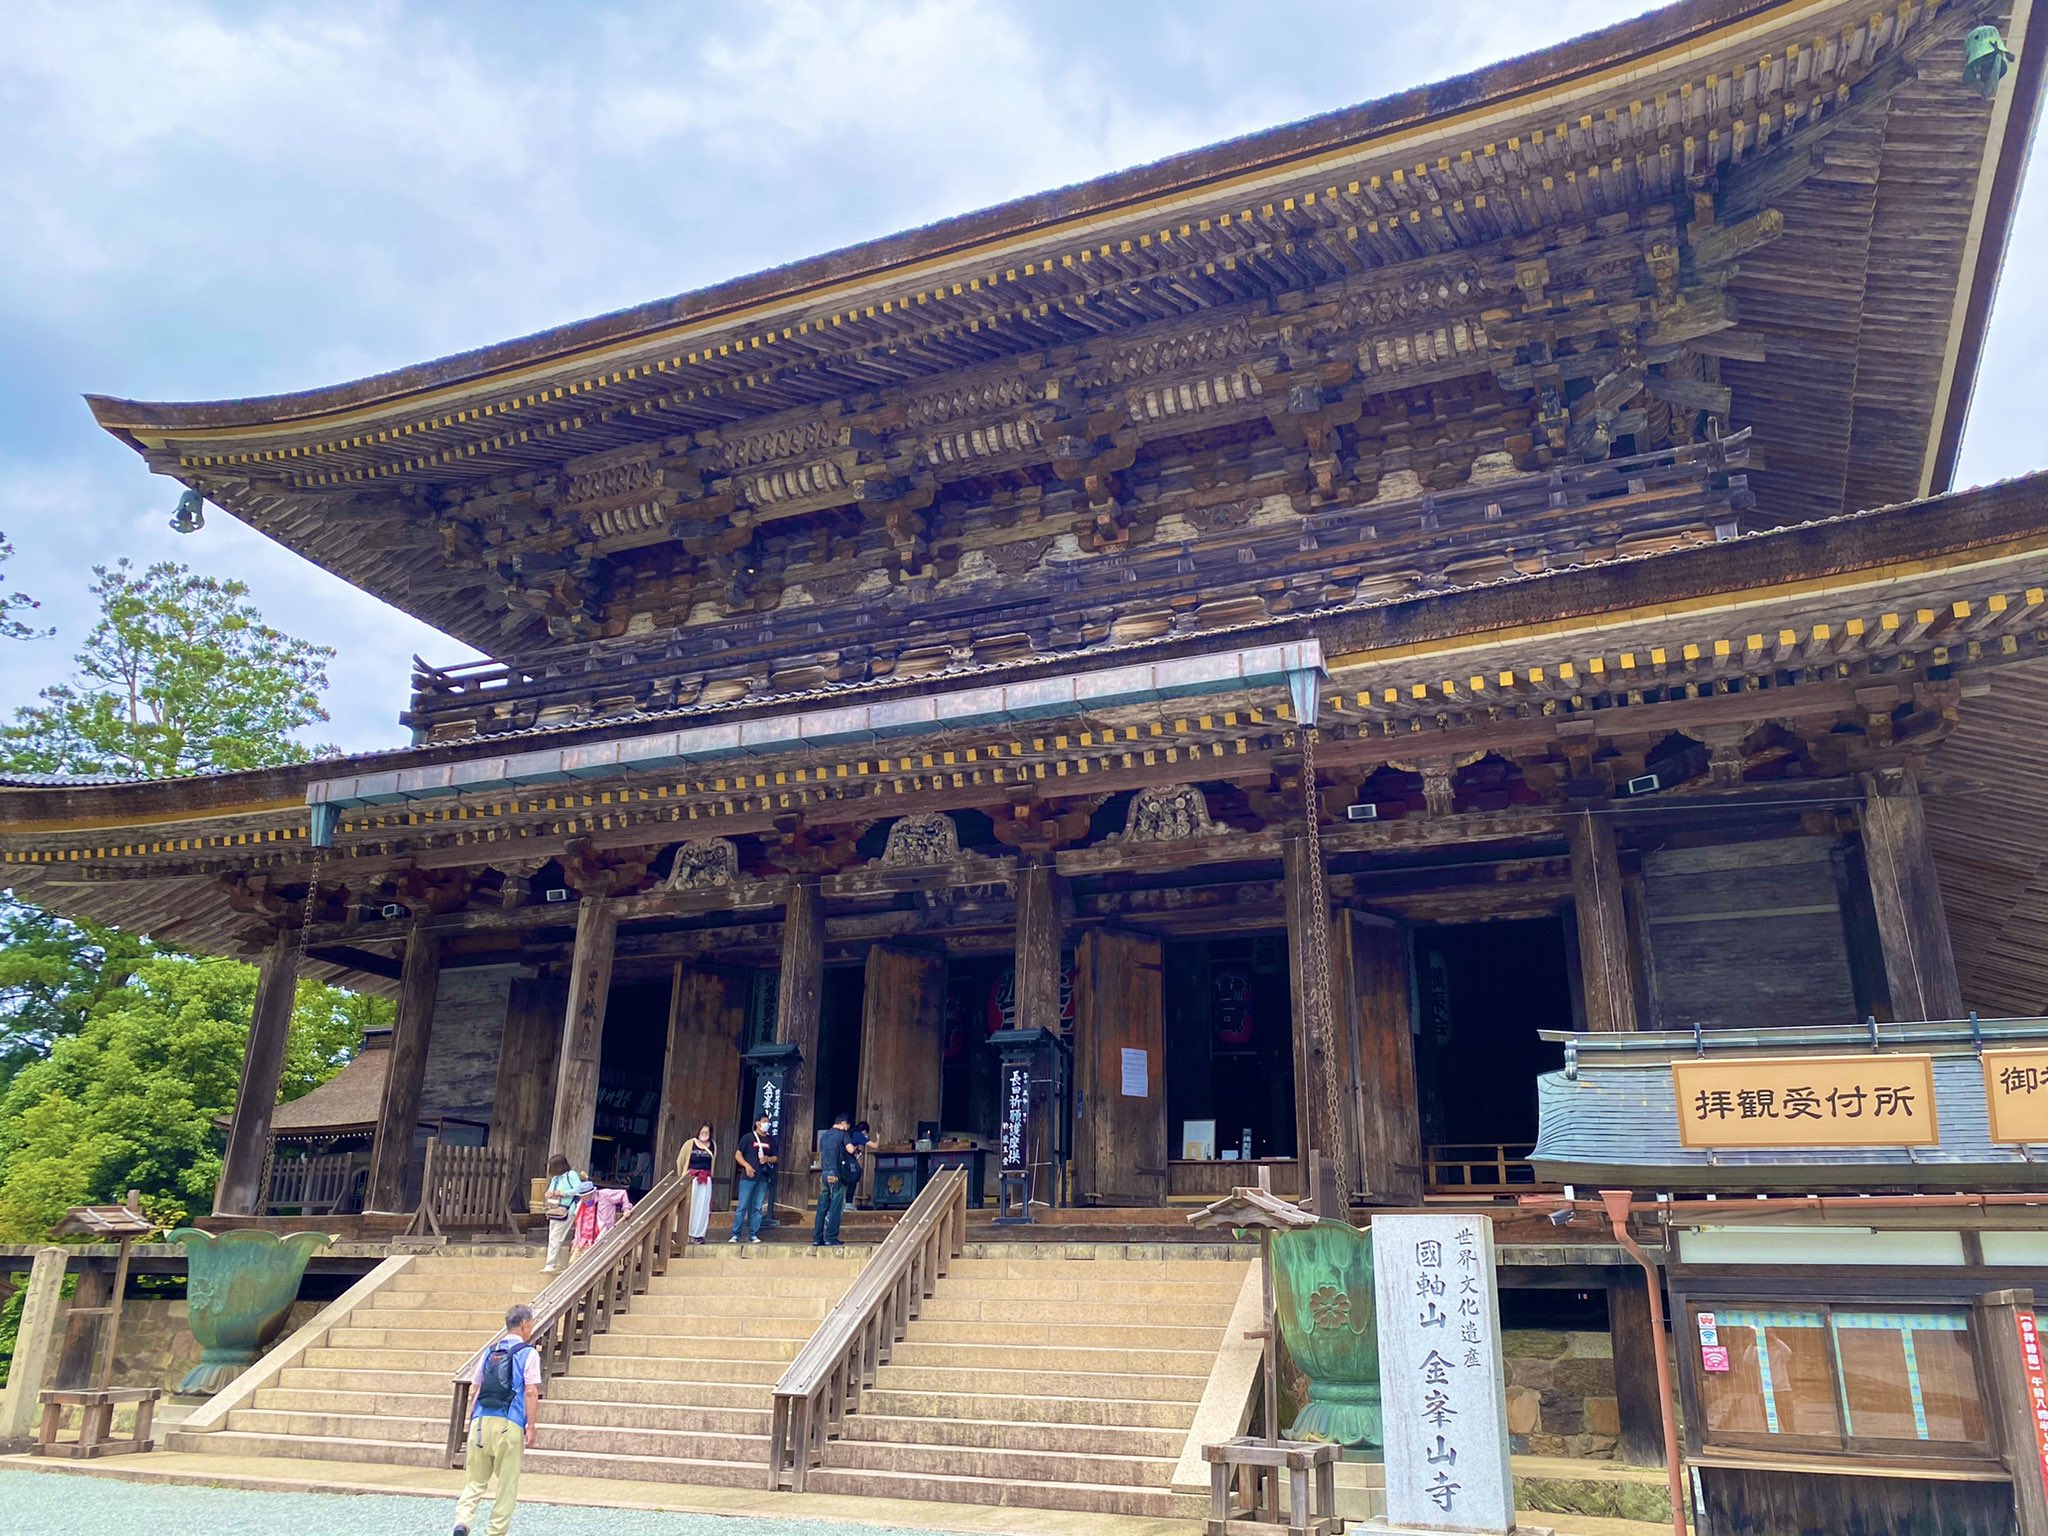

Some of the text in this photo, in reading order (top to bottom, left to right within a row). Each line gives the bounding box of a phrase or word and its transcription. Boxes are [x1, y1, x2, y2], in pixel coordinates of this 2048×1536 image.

[1694, 1085, 1915, 1120] 拝観受付所
[2000, 1066, 2048, 1095] 御
[1453, 1227, 1482, 1368] 世界文化遺産
[1415, 1239, 1461, 1513] 國軸山 金峯山寺
